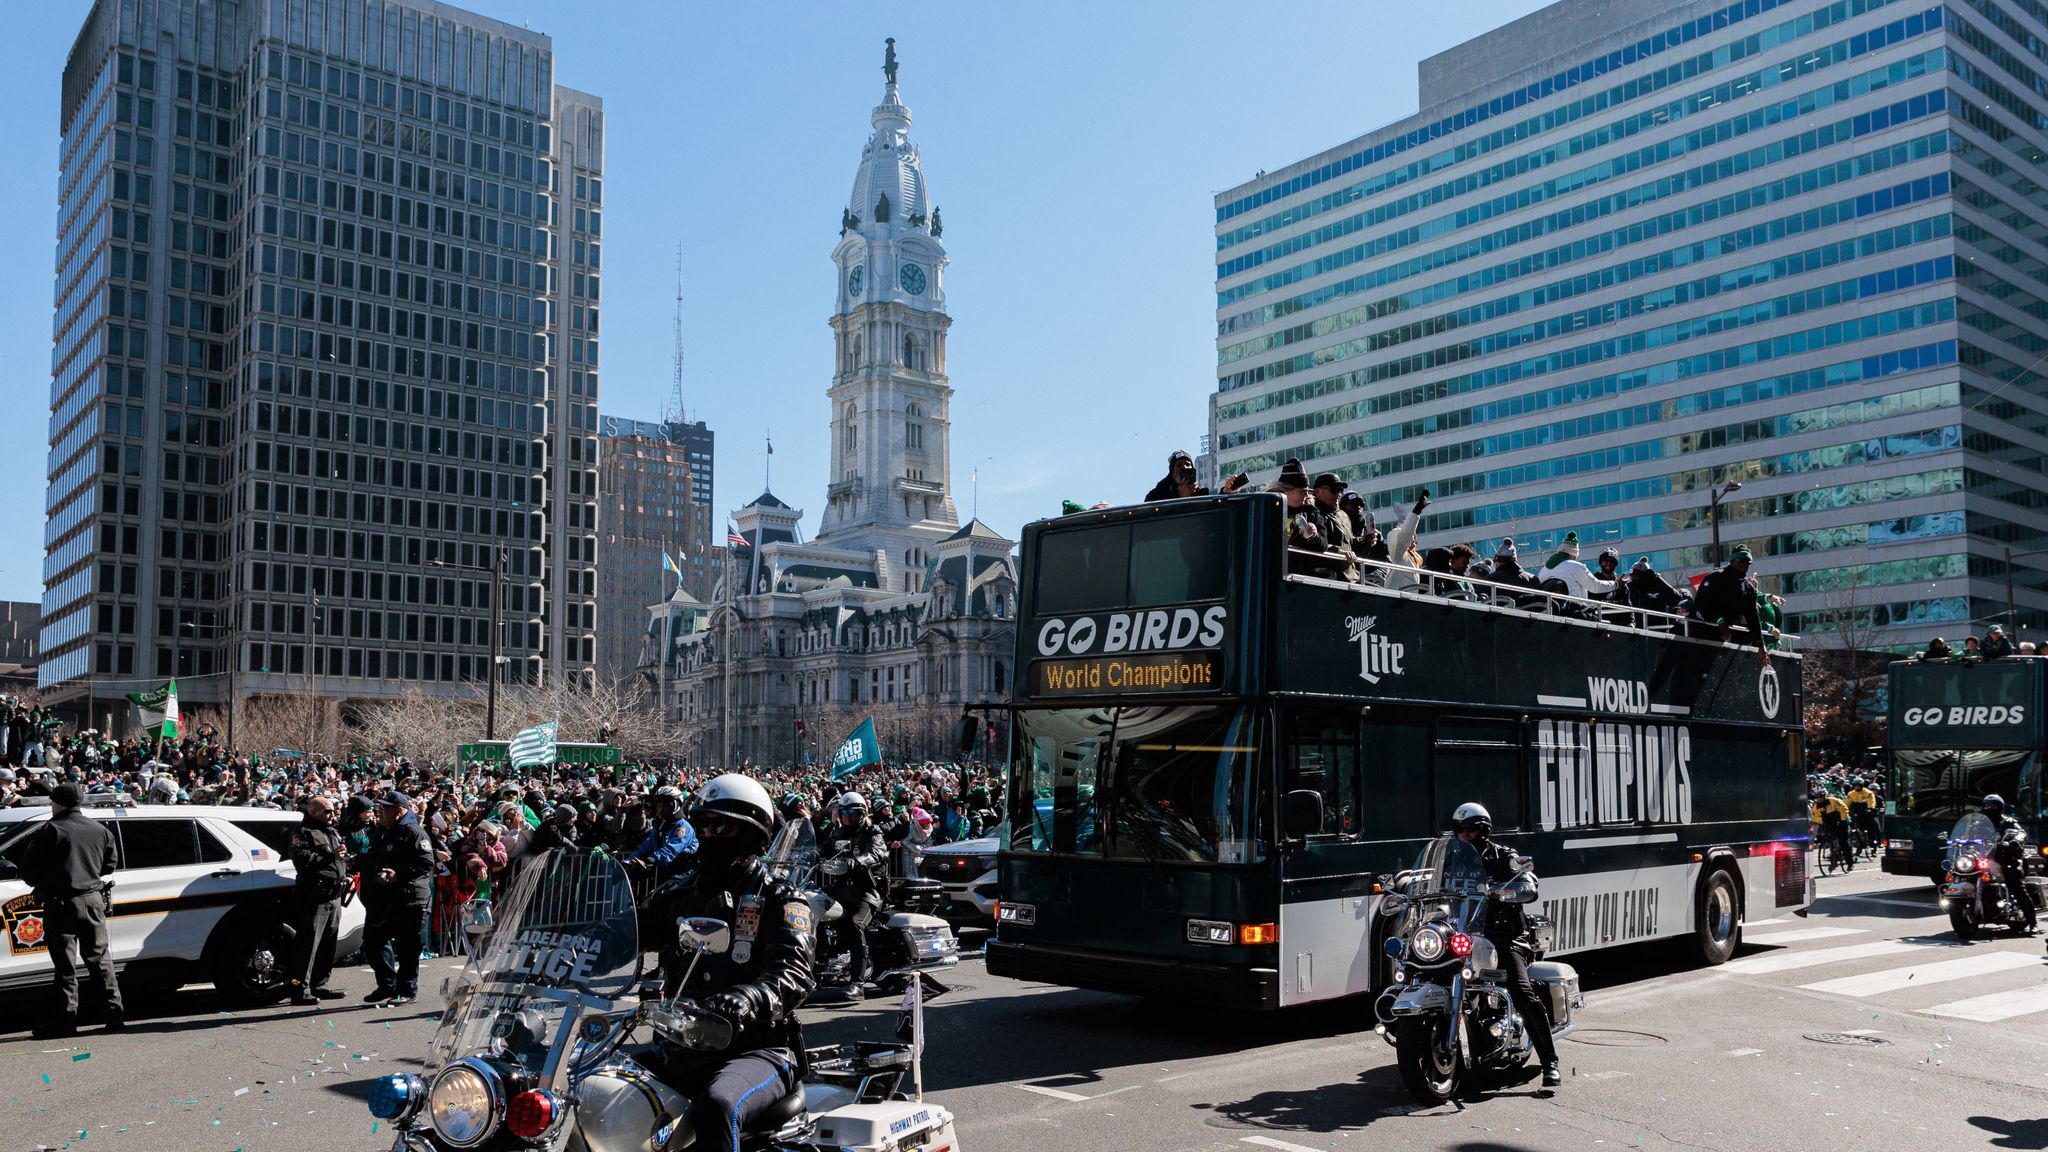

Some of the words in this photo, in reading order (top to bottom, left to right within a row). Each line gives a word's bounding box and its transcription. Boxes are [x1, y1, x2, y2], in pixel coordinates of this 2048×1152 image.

[1038, 617, 1097, 656] GO
[1103, 605, 1227, 653] BIRDS
[1344, 614, 1378, 638] Miller
[1348, 626, 1405, 685] Lite
[1046, 663, 1101, 690] World
[1107, 659, 1212, 689] Champions
[1588, 676, 1649, 714] WORLD
[1904, 707, 1943, 726] GO
[1947, 705, 2025, 726] BIRDS
[485, 745, 510, 761] CA
[555, 748, 599, 763] ARK
[1538, 718, 1693, 832] CHAMPIONS
[1542, 895, 1589, 953] THANK
[1593, 891, 1619, 945] YOU
[1622, 887, 1659, 940] FANS!
[490, 929, 602, 954] PHILADELPHIA
[480, 943, 597, 984] POLICE
[889, 1115, 913, 1135] HIGHWAY
[912, 1109, 931, 1126] PATROL
